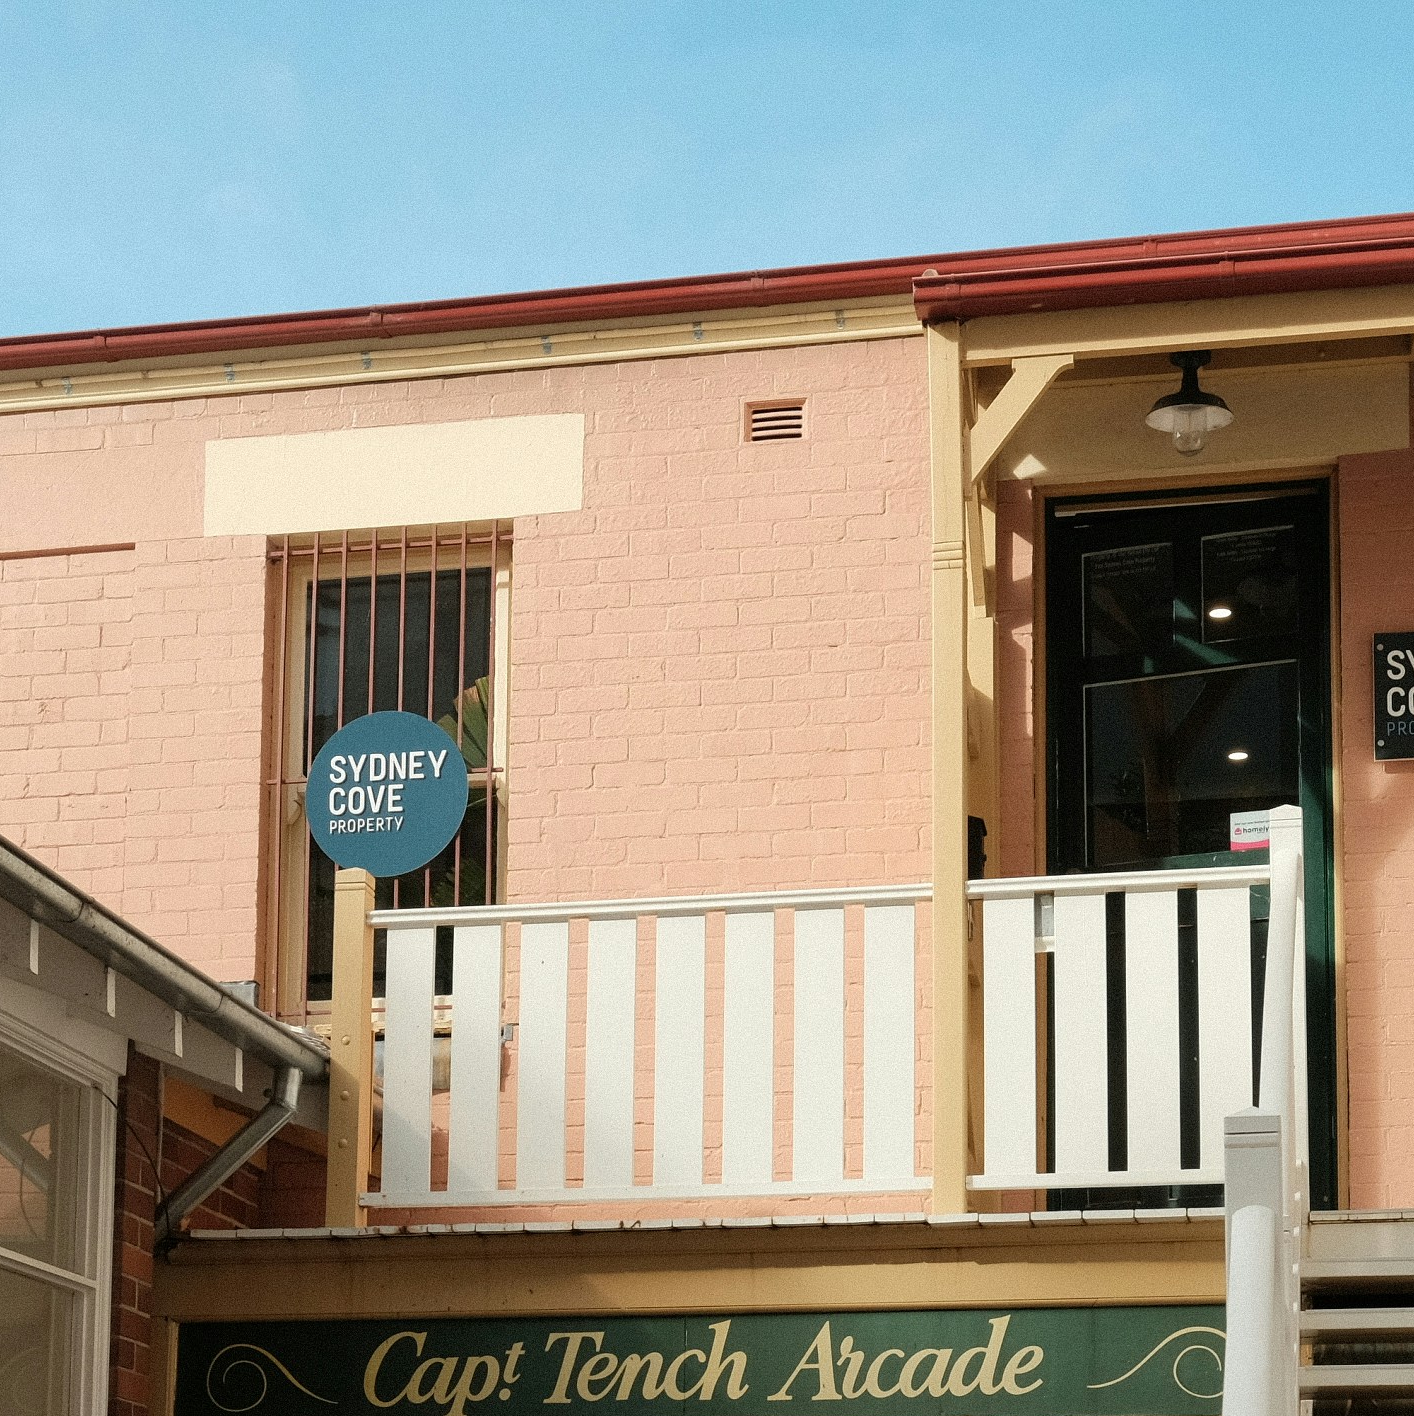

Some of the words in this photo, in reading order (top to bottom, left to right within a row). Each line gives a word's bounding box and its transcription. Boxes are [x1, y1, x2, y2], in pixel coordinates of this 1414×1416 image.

[329, 749, 448, 784] SYDNEY
[328, 783, 404, 816] COVE
[329, 816, 404, 834] PROPERTY
[542, 1318, 751, 1405] Tench
[767, 1314, 1045, 1403] Arcade
